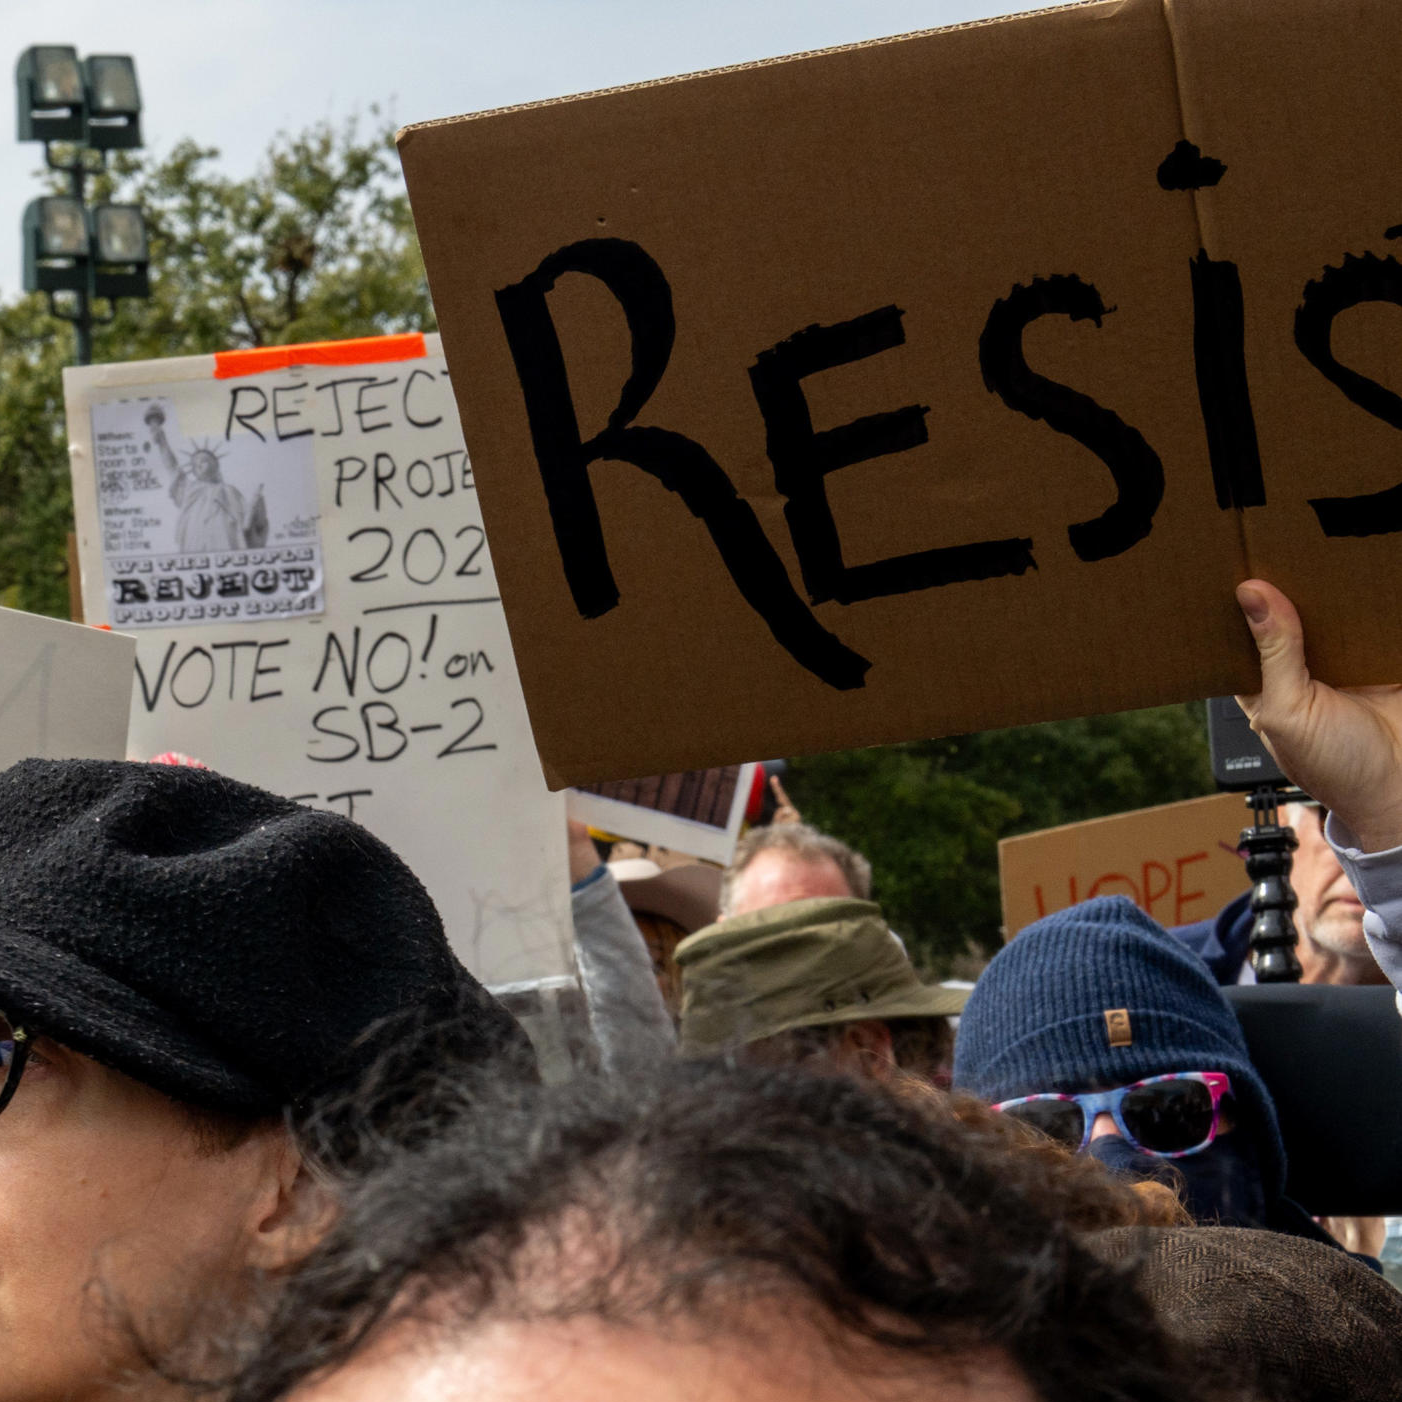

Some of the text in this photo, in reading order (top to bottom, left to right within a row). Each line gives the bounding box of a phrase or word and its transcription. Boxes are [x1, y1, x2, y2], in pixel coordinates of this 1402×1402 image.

[225, 369, 449, 443] REJEC
[494, 139, 1402, 692] RESIS
[334, 449, 476, 512] PROJE
[112, 567, 315, 605] REJECT
[158, 556, 210, 572] THE
[216, 548, 314, 569] PEOPLE
[348, 524, 486, 586] 202
[114, 602, 240, 624] PROJECT
[135, 613, 495, 712] VOTE NO! on
[306, 696, 497, 763] SB-2
